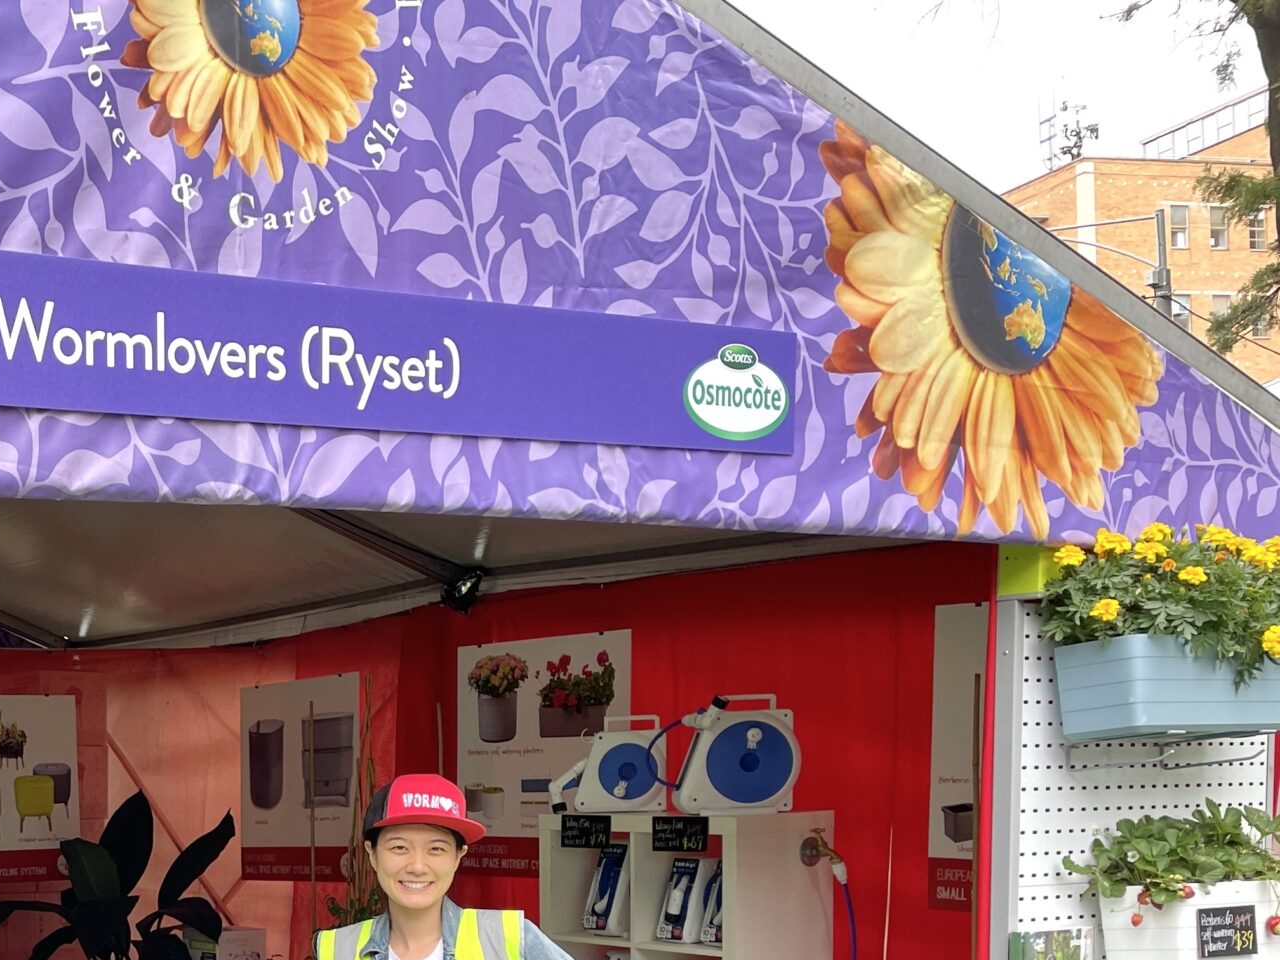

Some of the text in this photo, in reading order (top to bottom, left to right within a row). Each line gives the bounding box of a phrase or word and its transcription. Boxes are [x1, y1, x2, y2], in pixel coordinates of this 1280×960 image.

[69, 6, 142, 166] Flower
[171, 173, 198, 210] &
[228, 183, 355, 229] Garden
[723, 349, 754, 364] Scotts
[300, 325, 461, 411] (Ryset)
[936, 886, 967, 901] SMALL
[1234, 930, 1254, 952] $39
